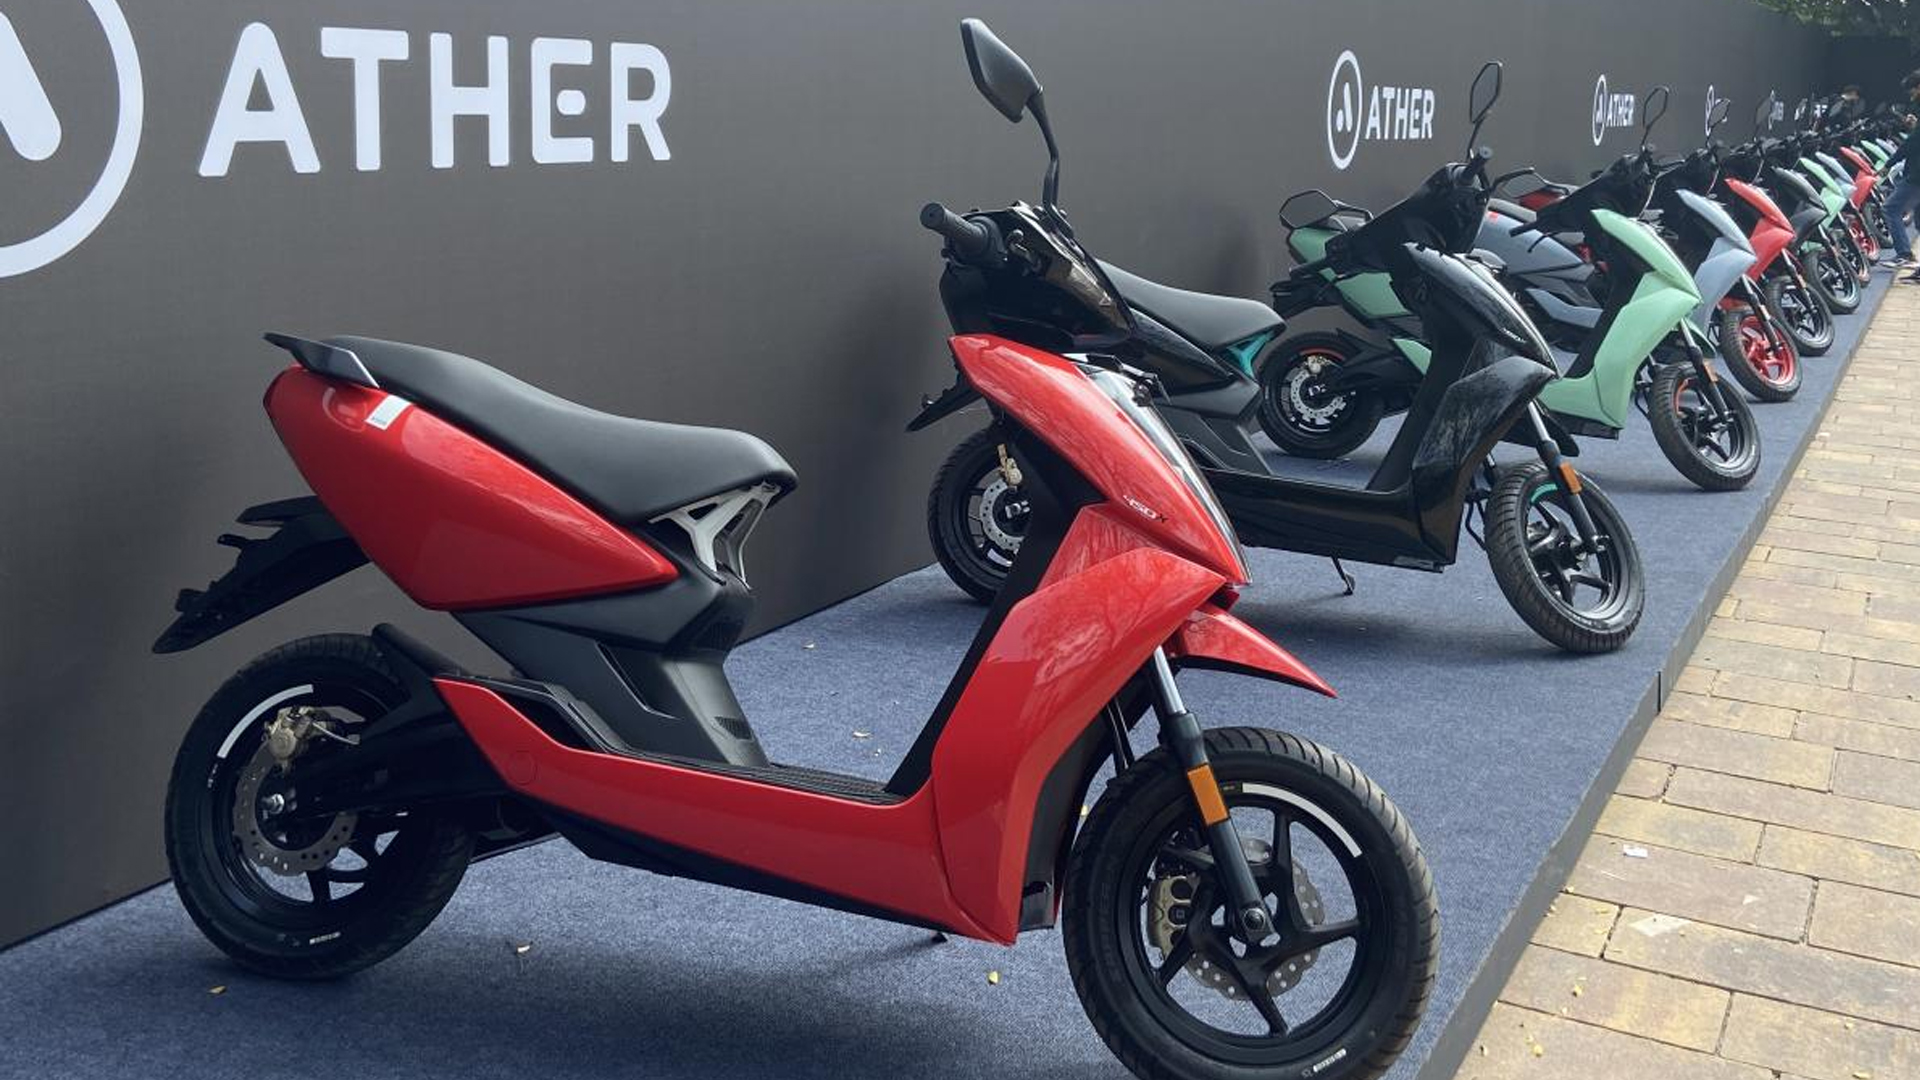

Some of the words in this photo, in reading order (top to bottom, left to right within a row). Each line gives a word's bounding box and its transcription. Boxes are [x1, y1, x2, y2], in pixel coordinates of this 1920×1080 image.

[199, 22, 671, 177] ATHER
[1365, 85, 1435, 140] ATHER
[1606, 93, 1634, 127] ATHER
